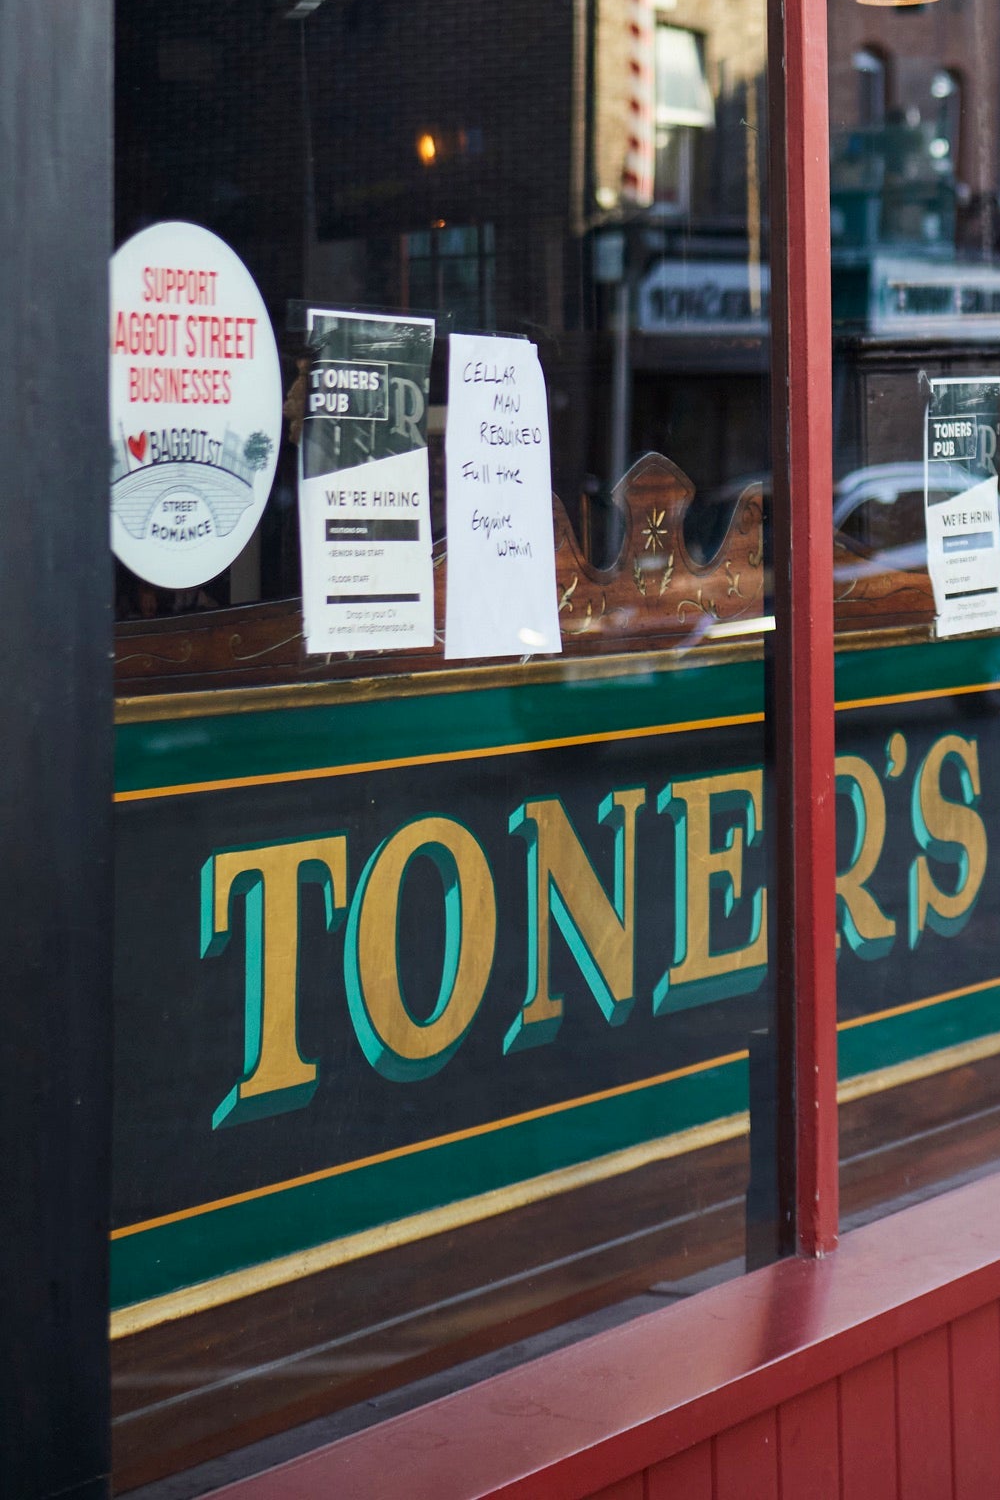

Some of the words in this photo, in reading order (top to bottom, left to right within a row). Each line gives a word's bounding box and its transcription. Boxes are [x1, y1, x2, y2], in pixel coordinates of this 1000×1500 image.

[142, 266, 218, 306] SUPPORT
[112, 311, 180, 356] AGGOT
[185, 314, 258, 360] STREET
[309, 368, 380, 391] TONERS
[463, 361, 516, 384] CELLAR
[128, 366, 232, 405] BUSINESSES
[309, 393, 349, 413] PUB
[493, 394, 521, 413] MAN
[933, 421, 972, 439] TONERS
[149, 428, 208, 464] BAGGOT
[933, 441, 956, 457] PUB
[462, 461, 490, 484] Full
[496, 463, 523, 484] time
[162, 500, 199, 513] STREET
[325, 490, 367, 507] WE'RE
[373, 491, 420, 507] HIRING
[152, 520, 212, 541] ROMANCE
[175, 514, 187, 525] OF
[471, 509, 513, 539] Enquire
[200, 729, 988, 1128] TONER'S
